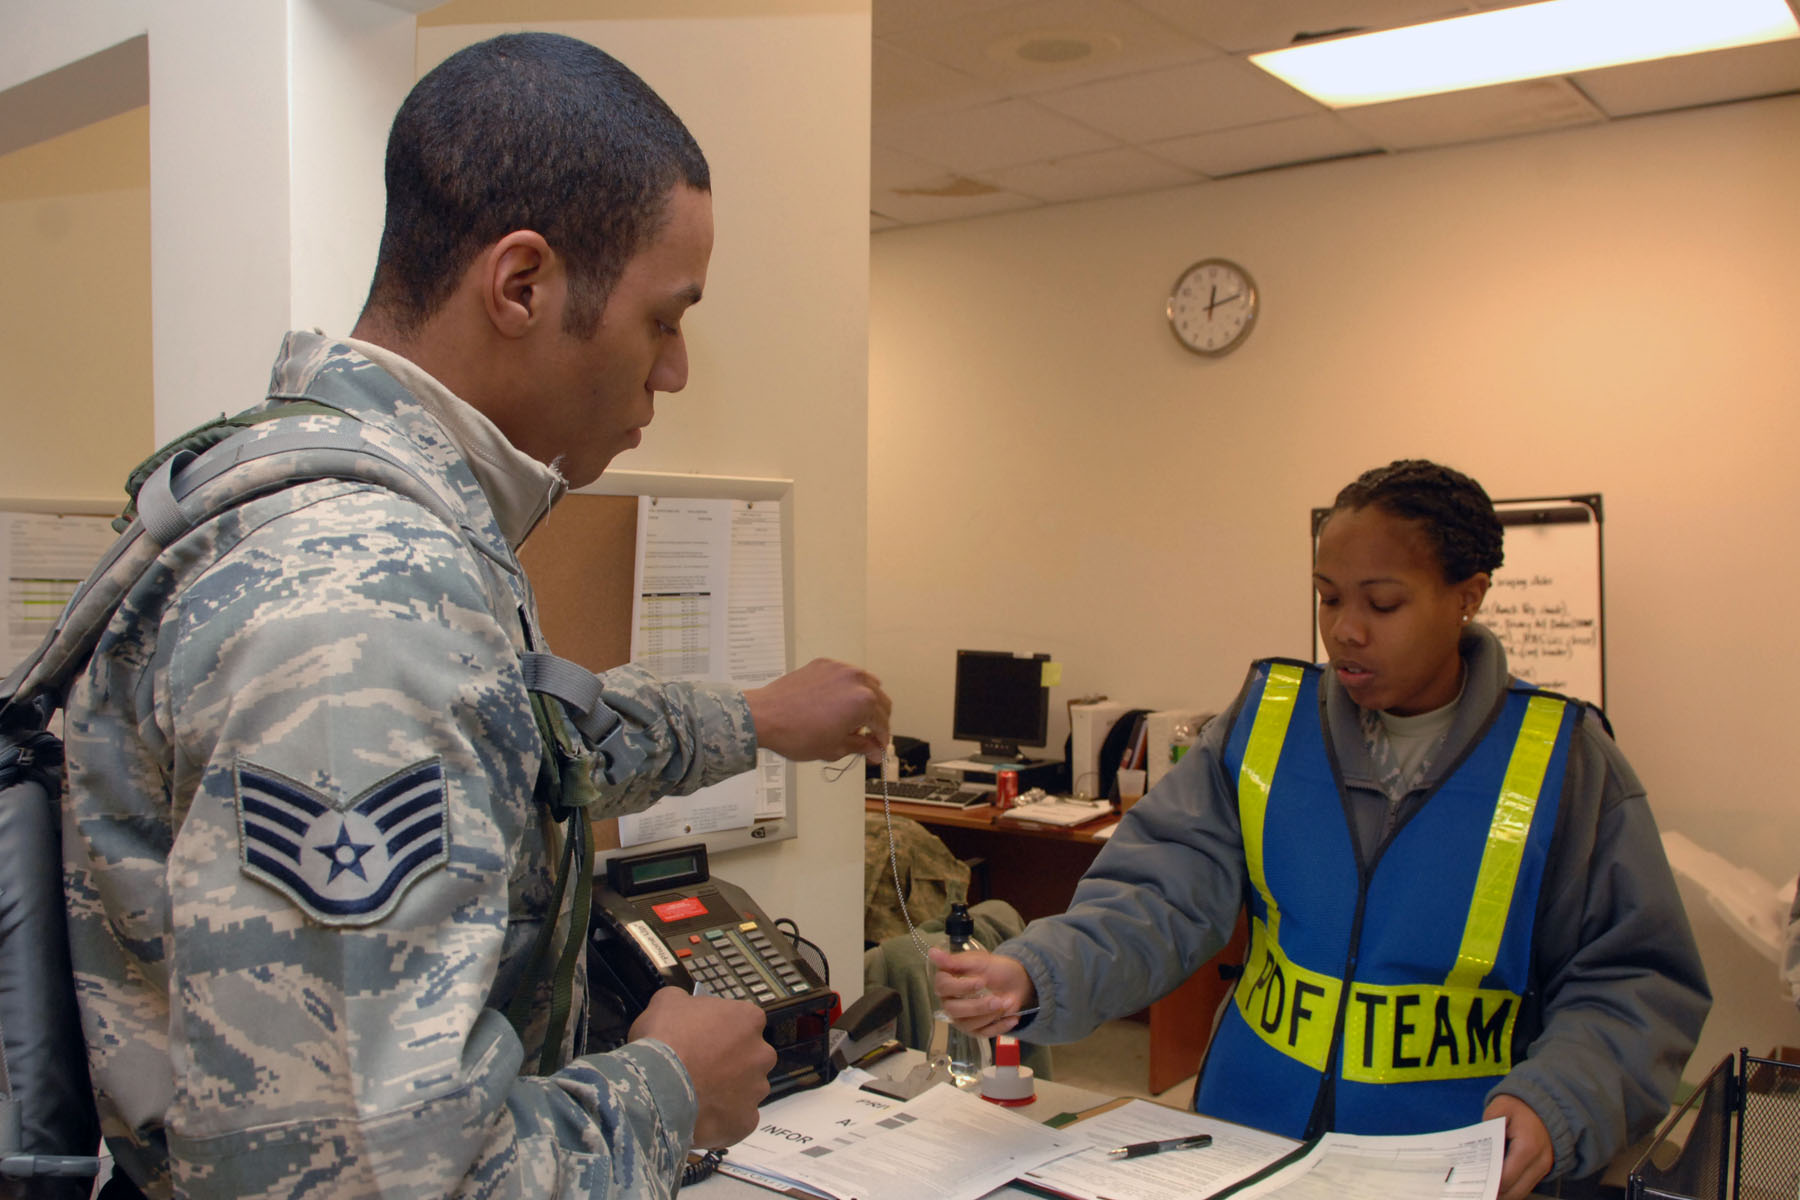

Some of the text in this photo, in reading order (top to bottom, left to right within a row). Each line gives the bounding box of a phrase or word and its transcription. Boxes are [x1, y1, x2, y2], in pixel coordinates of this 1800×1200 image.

[1245, 948, 1513, 1069] PDF TEAM
[760, 1124, 814, 1144] INFOR
